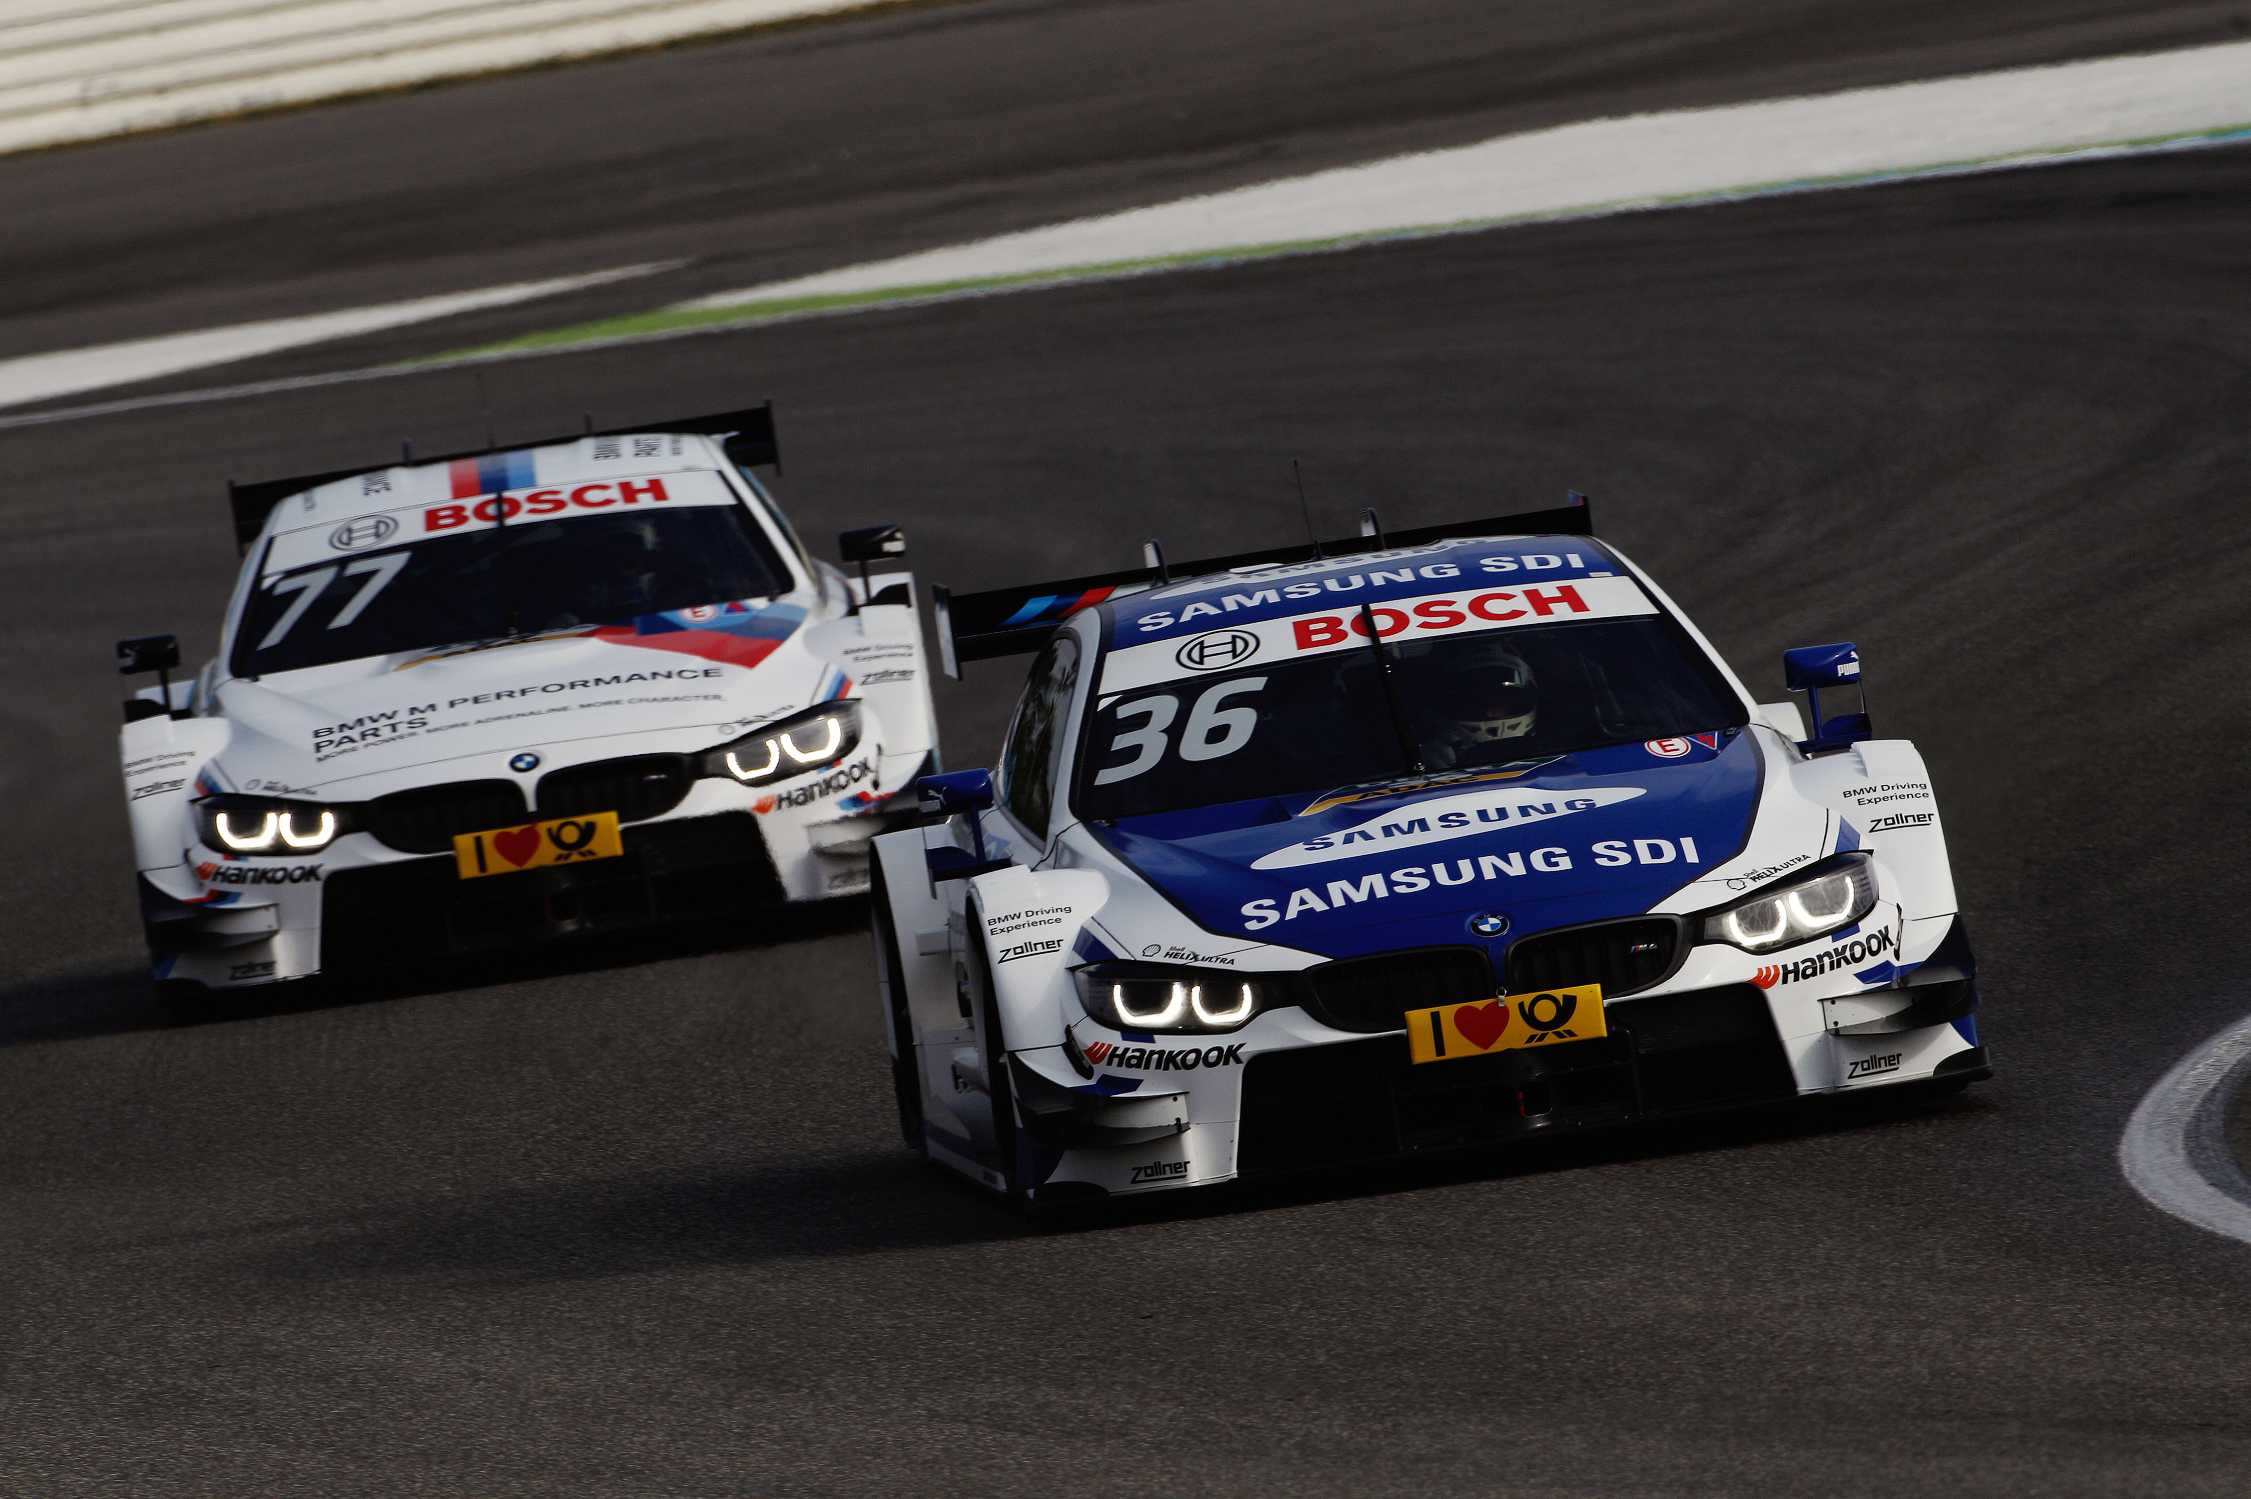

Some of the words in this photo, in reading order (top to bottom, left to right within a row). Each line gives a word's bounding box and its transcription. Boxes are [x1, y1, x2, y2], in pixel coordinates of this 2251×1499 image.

[423, 478, 669, 533] BOSCH
[257, 551, 413, 651] 77
[1136, 563, 1463, 631] SAMSUNG
[1479, 553, 1585, 573] SDI
[1292, 585, 1590, 650] BOSCH
[313, 710, 399, 738] BMW
[409, 703, 438, 716] M
[449, 668, 724, 708] PERFORMANCE
[314, 717, 429, 753] PARTS
[1094, 676, 1269, 786] 36
[1843, 786, 1877, 798] BMW
[1881, 782, 1927, 792] Driving
[1857, 792, 1929, 805] Experience
[1302, 798, 1598, 852] SAMSUNG
[475, 836, 487, 873] I
[1780, 855, 1812, 869] ULTRA
[1240, 846, 1574, 931] SAMSUNG
[1593, 836, 1700, 867] SDI
[987, 912, 1021, 926] BMW
[1025, 906, 1072, 918] Driving
[990, 917, 1062, 936] Experience
[1430, 1011, 1446, 1057] I
